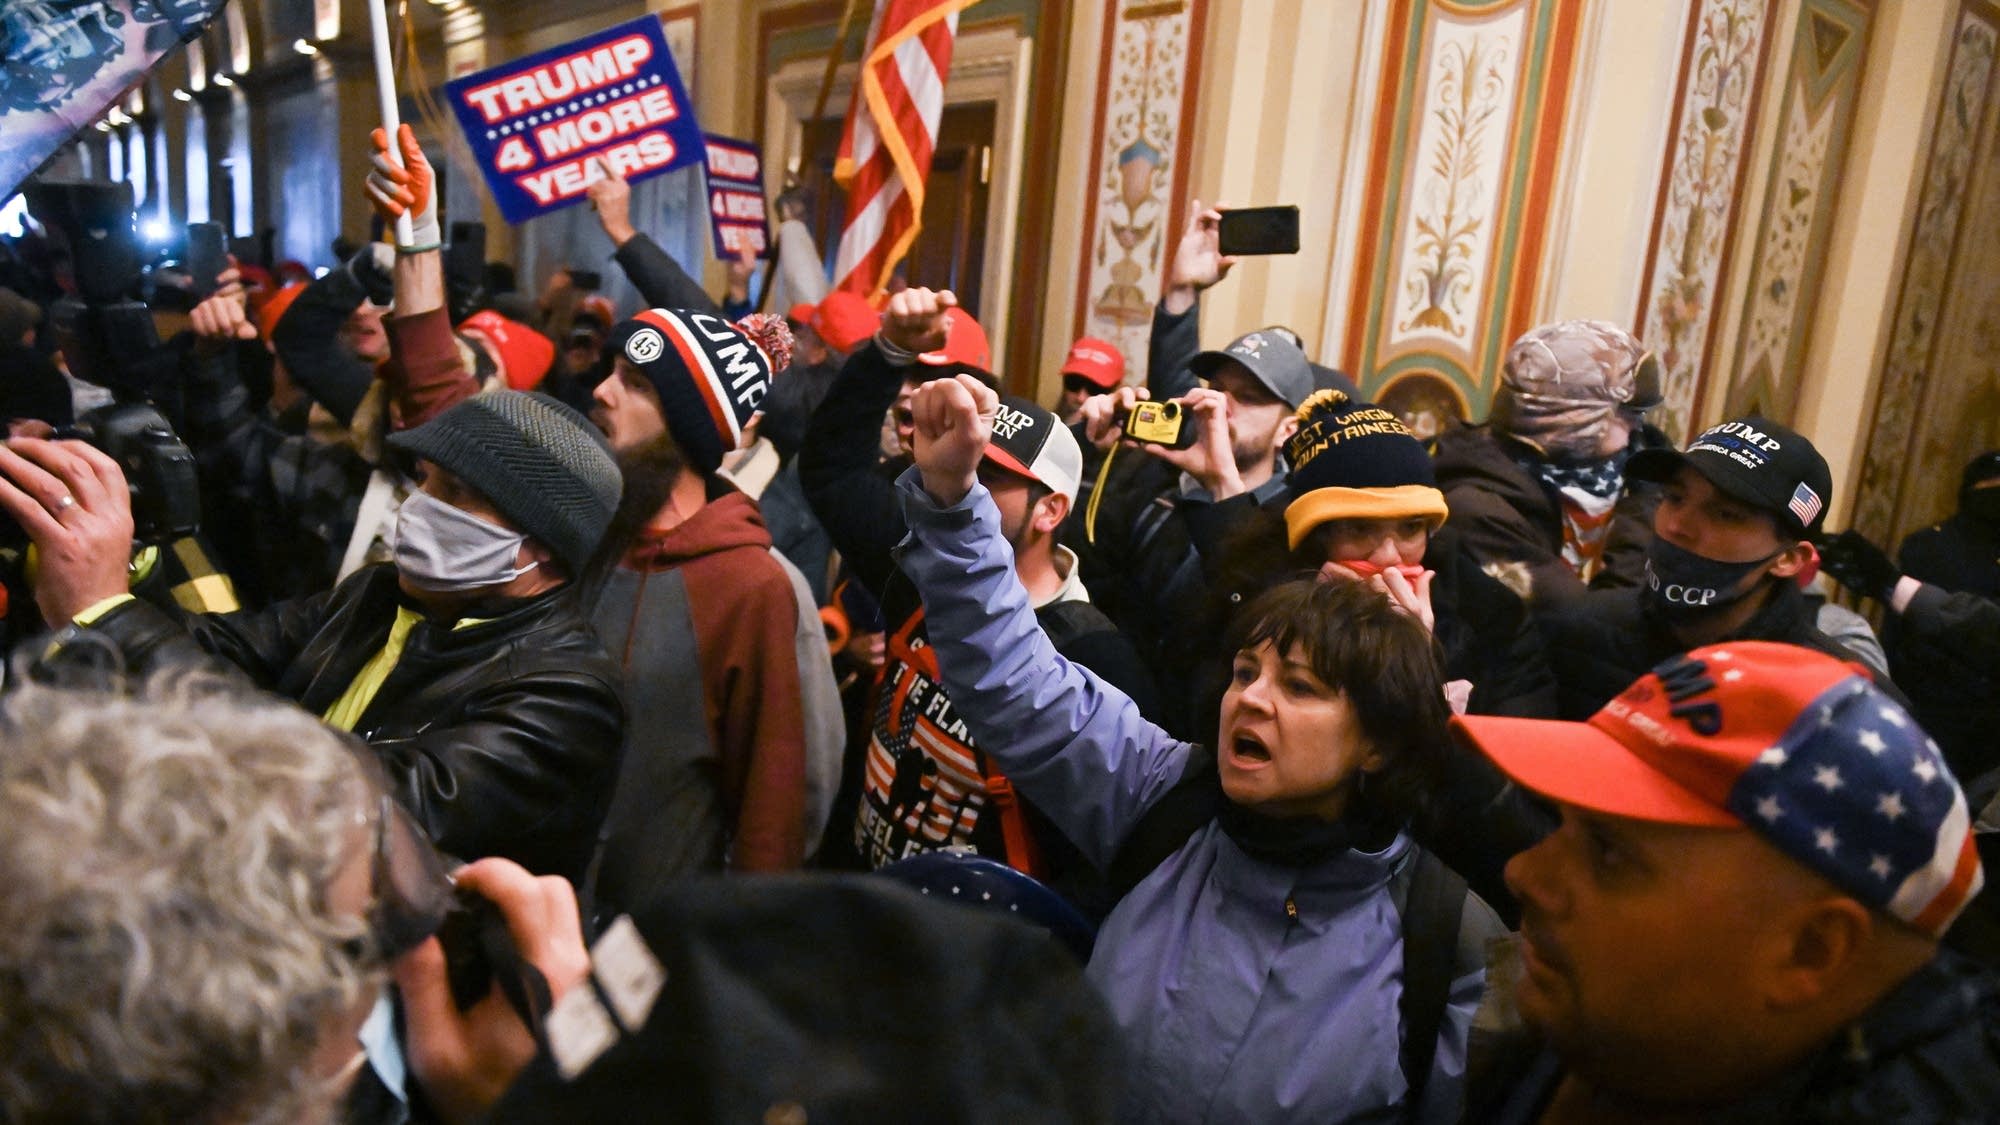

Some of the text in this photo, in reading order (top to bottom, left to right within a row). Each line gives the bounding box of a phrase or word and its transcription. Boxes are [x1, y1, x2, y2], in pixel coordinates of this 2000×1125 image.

[465, 36, 652, 121] TRUMP
[497, 87, 677, 171] 4 MORE
[519, 132, 675, 205] YEARS
[633, 336, 658, 356] 45
[677, 308, 768, 410] UMP
[991, 419, 1018, 440] IN
[994, 403, 1035, 431] MP
[1664, 584, 1717, 606] CCP
